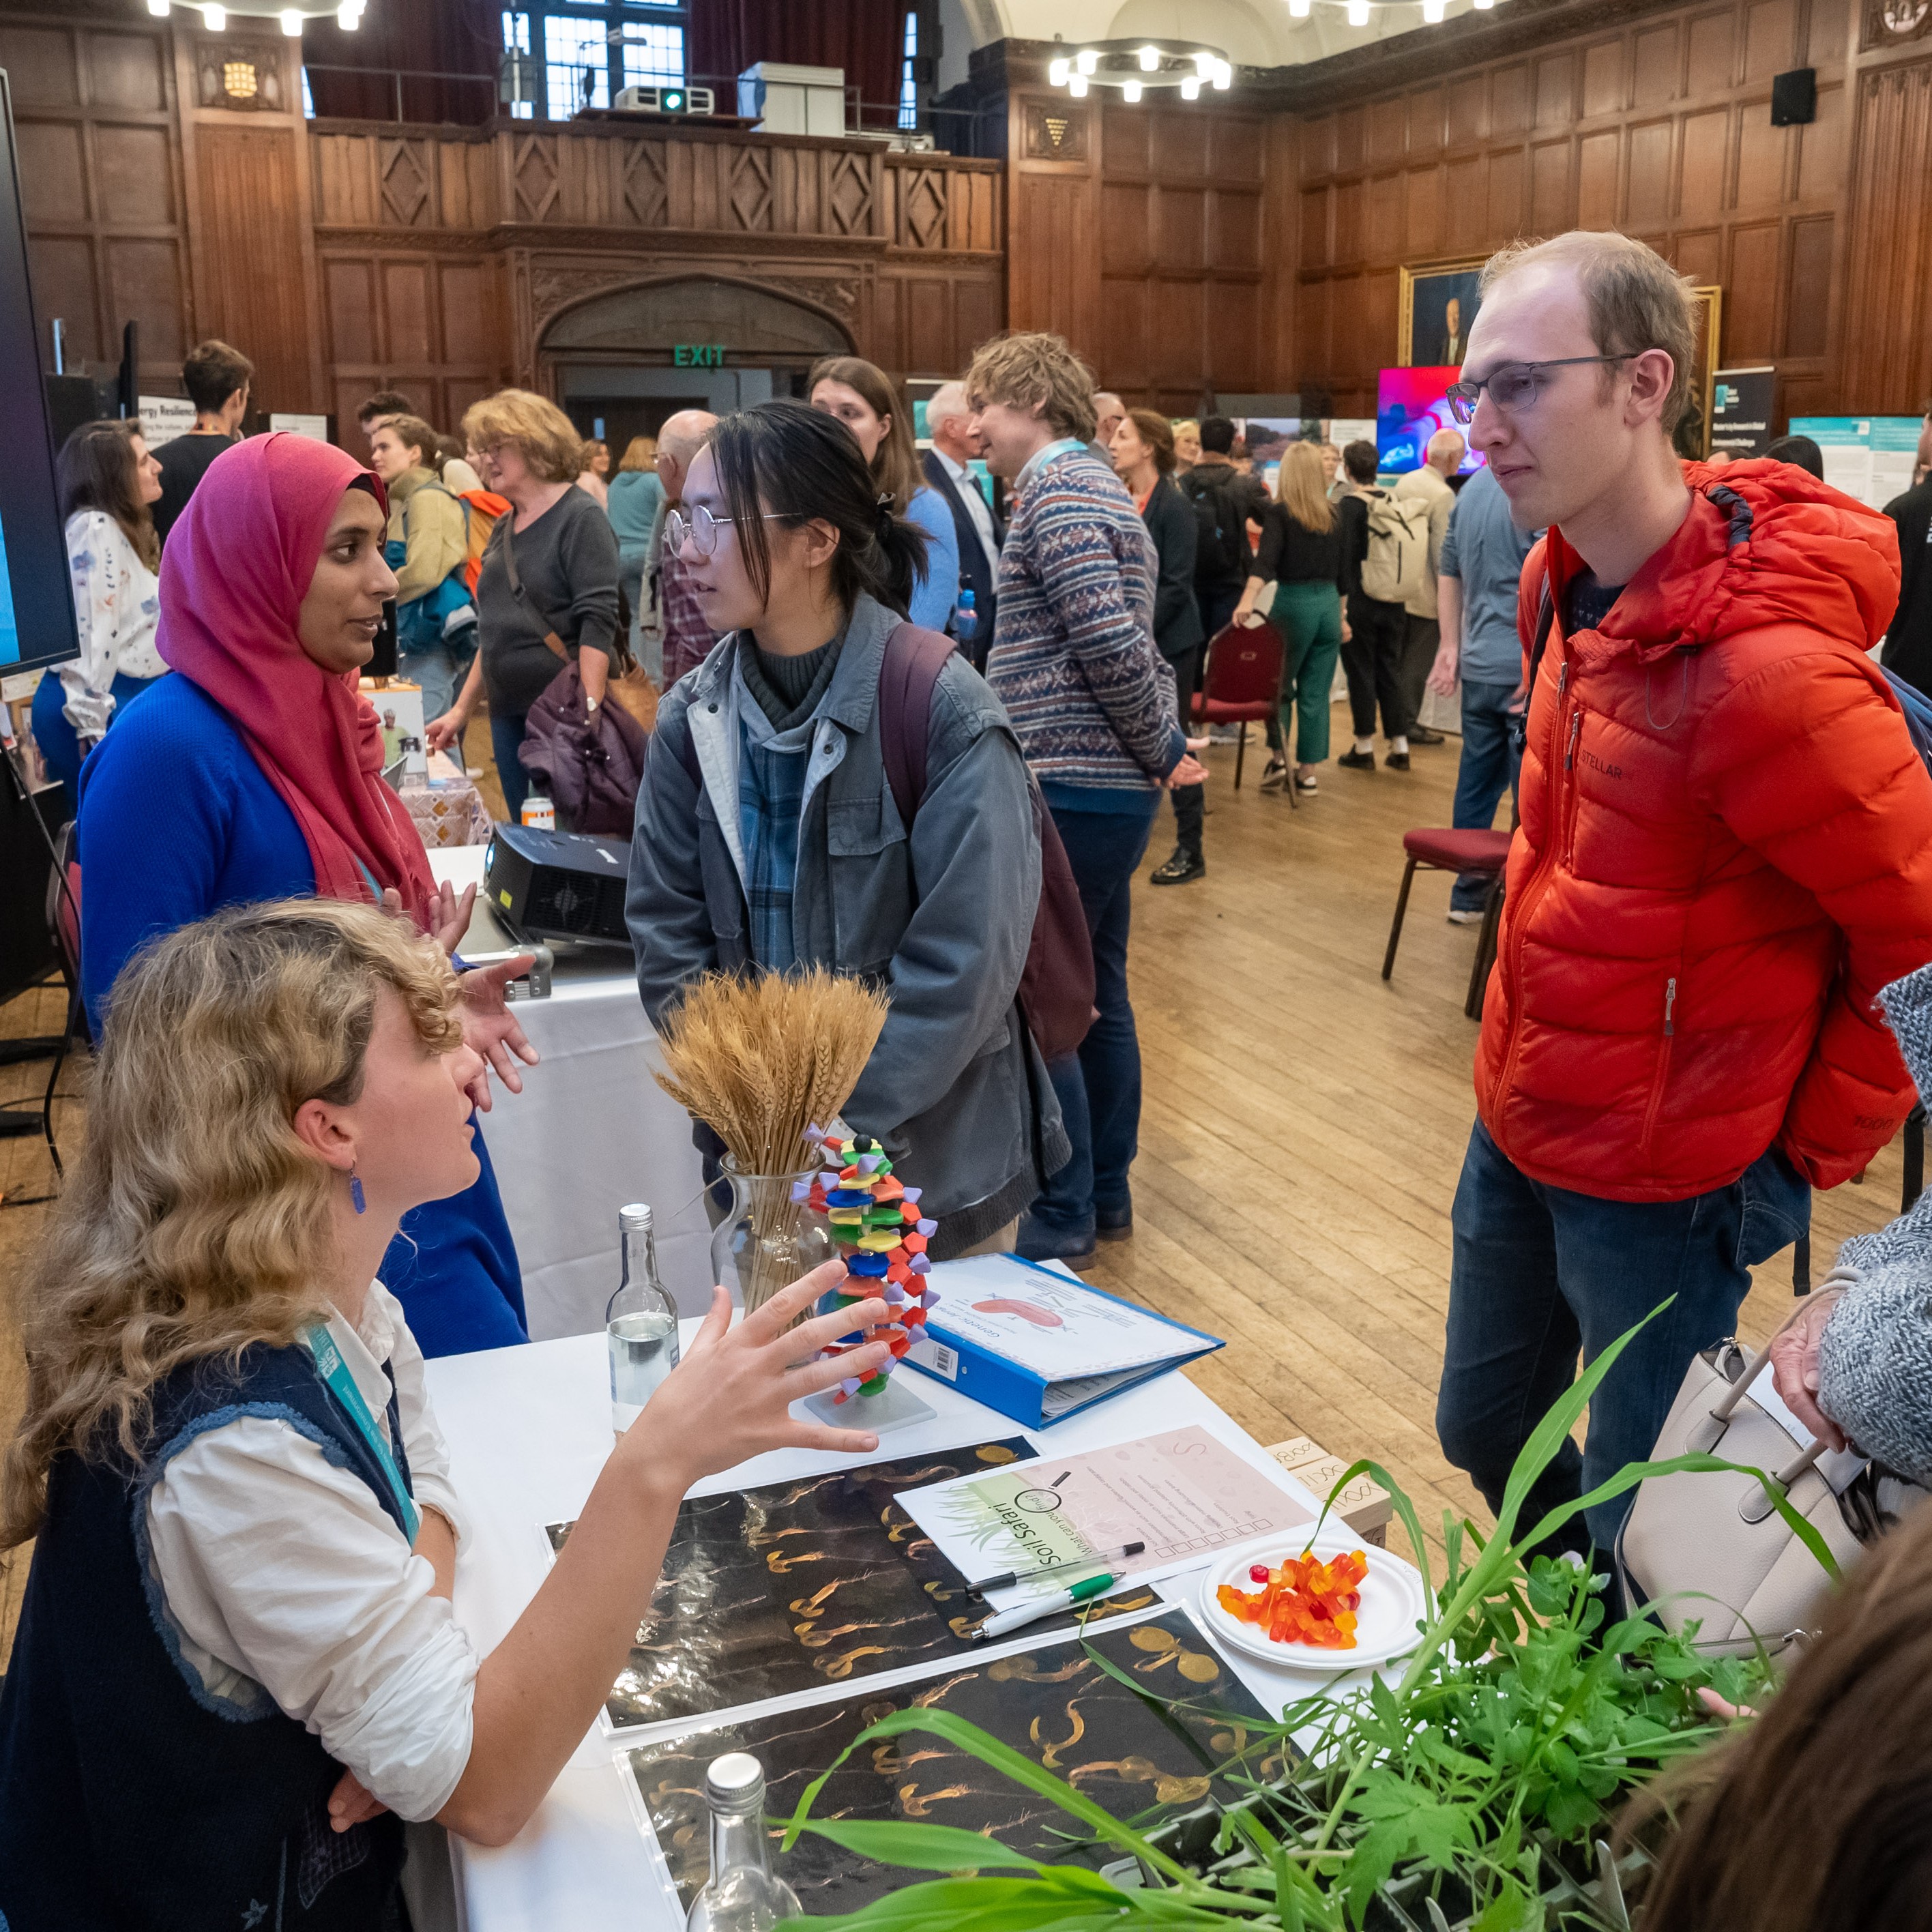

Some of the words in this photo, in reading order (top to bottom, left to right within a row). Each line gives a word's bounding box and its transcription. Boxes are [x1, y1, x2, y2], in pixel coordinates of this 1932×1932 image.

[674, 345, 727, 366] EXIT
[1581, 750, 1622, 780] STELLAR
[958, 1317, 1000, 1338] Genetic
[343, 1386, 372, 1433] Environment
[1025, 1494, 1047, 1509] find?
[991, 1502, 1037, 1540] Safari
[1044, 1512, 1064, 1523] you
[1057, 1524, 1074, 1535] can
[1023, 1540, 1062, 1565] Soil
[1068, 1536, 1093, 1554] What
